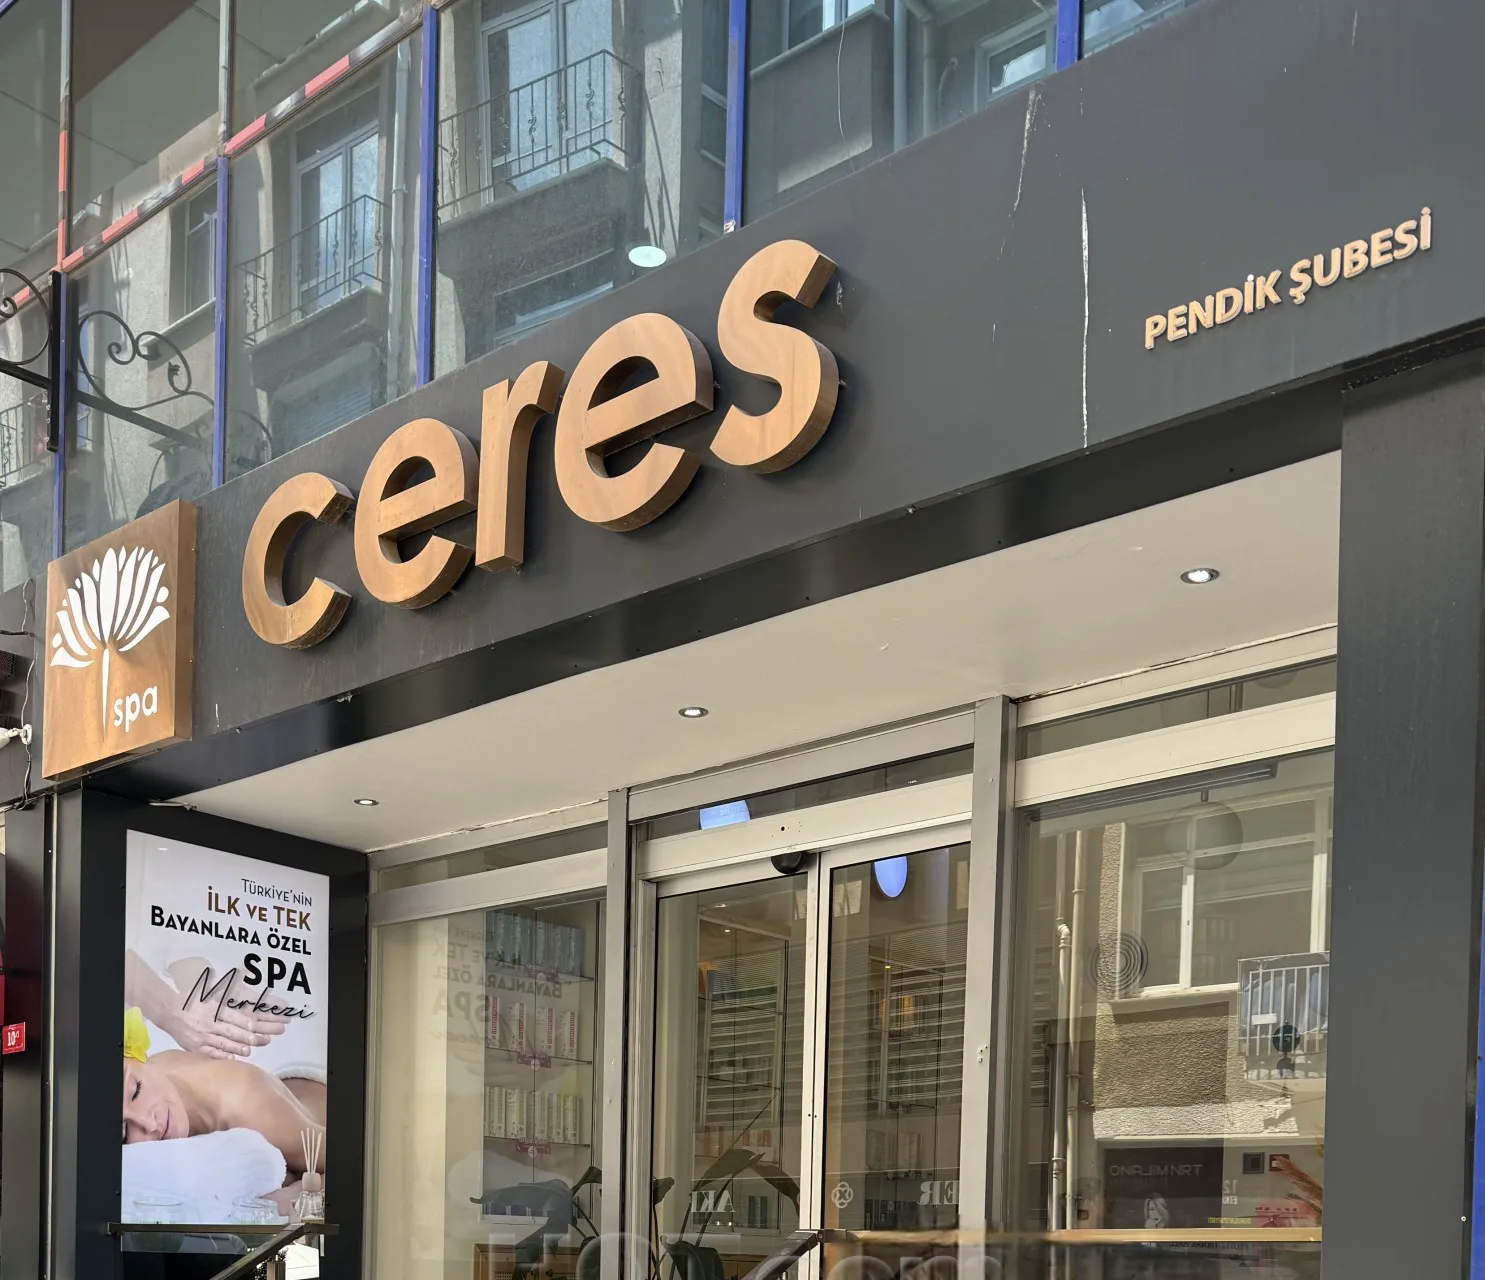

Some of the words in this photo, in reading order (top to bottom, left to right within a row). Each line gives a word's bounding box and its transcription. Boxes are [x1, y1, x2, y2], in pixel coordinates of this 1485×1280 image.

[1144, 269, 1282, 350] PENDİK
[1289, 206, 1432, 304] ŞUBESİ
[242, 239, 840, 650] ceres
[113, 685, 158, 733] spa
[151, 905, 262, 946] BAYANLARA
[267, 928, 312, 956] ÖZEL
[207, 885, 241, 917] İLK
[273, 905, 312, 932] TEK
[182, 966, 315, 1023] Merkezi
[243, 953, 312, 995] SPA
